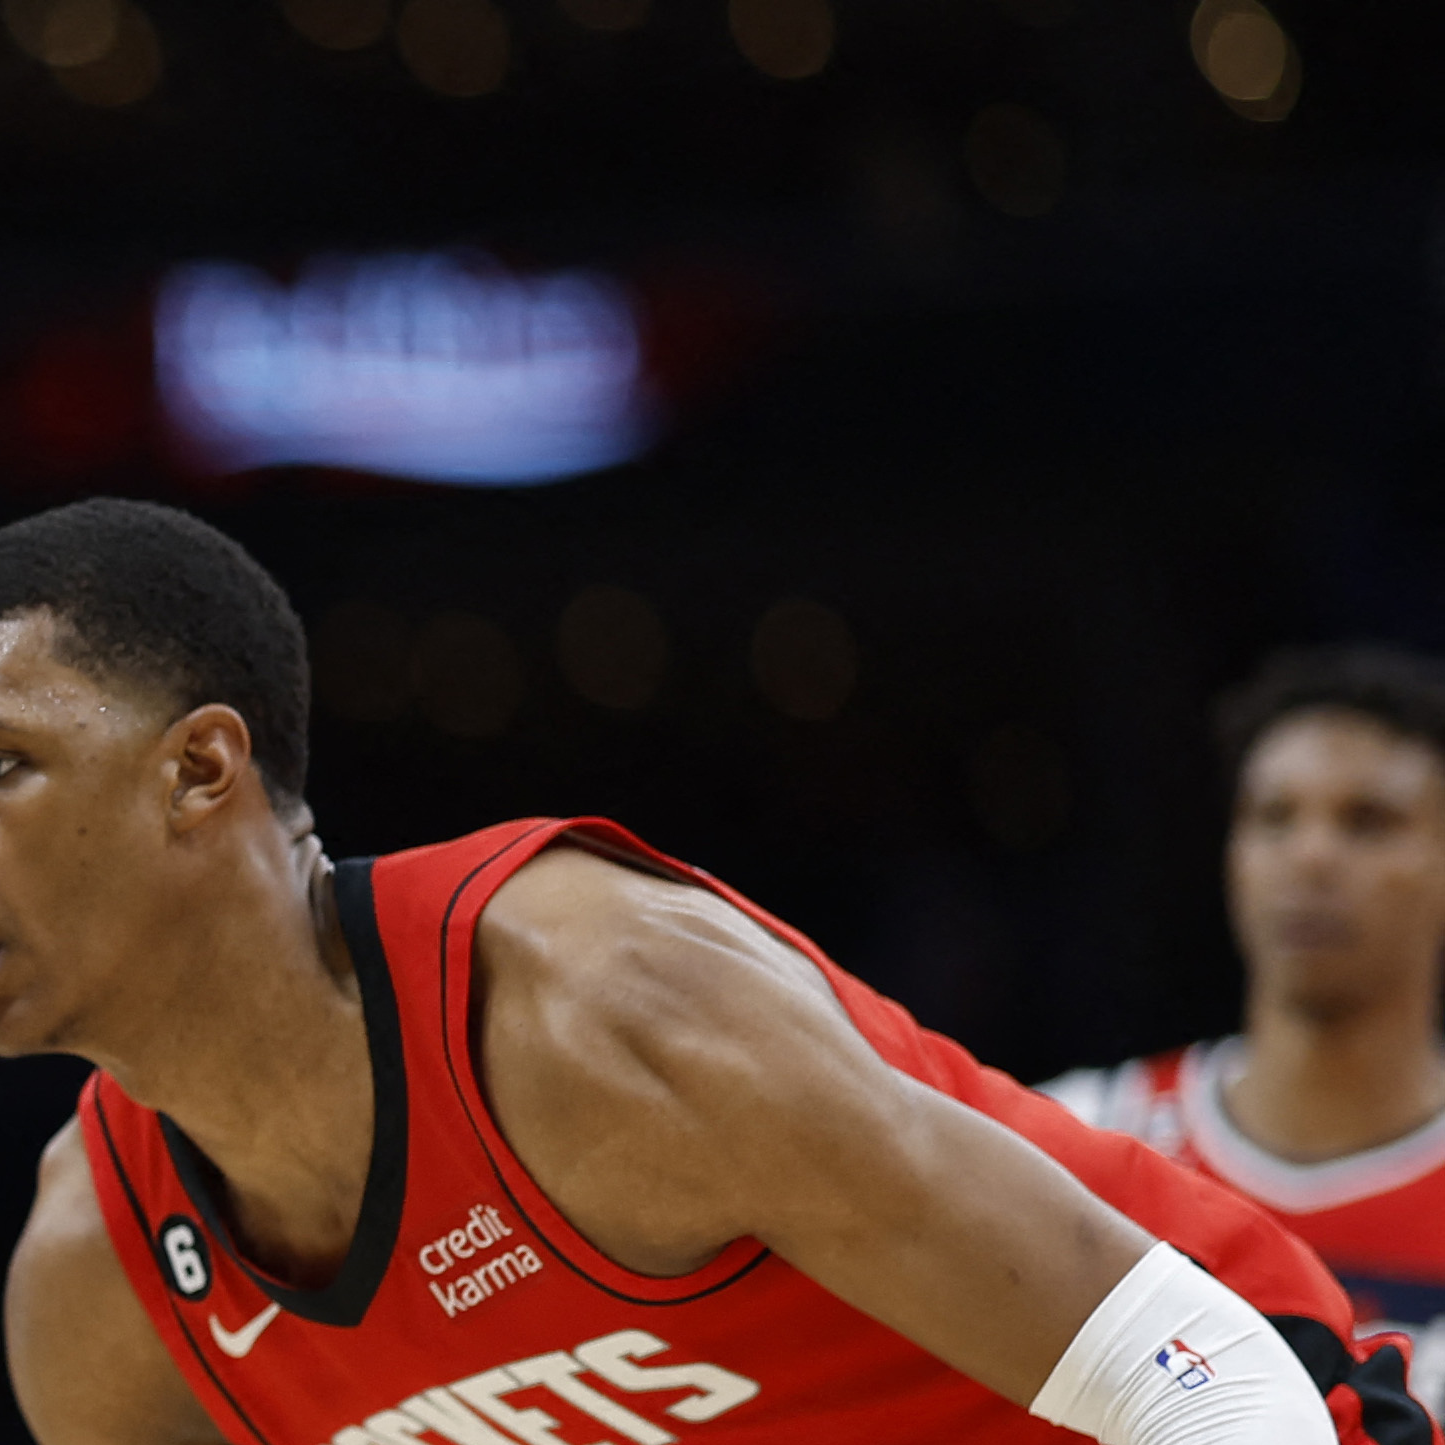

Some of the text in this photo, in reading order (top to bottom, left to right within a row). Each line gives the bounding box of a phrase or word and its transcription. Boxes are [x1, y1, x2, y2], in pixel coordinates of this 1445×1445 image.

[163, 1223, 208, 1295] 6
[418, 1203, 514, 1276] credit
[427, 1243, 544, 1319] karma
